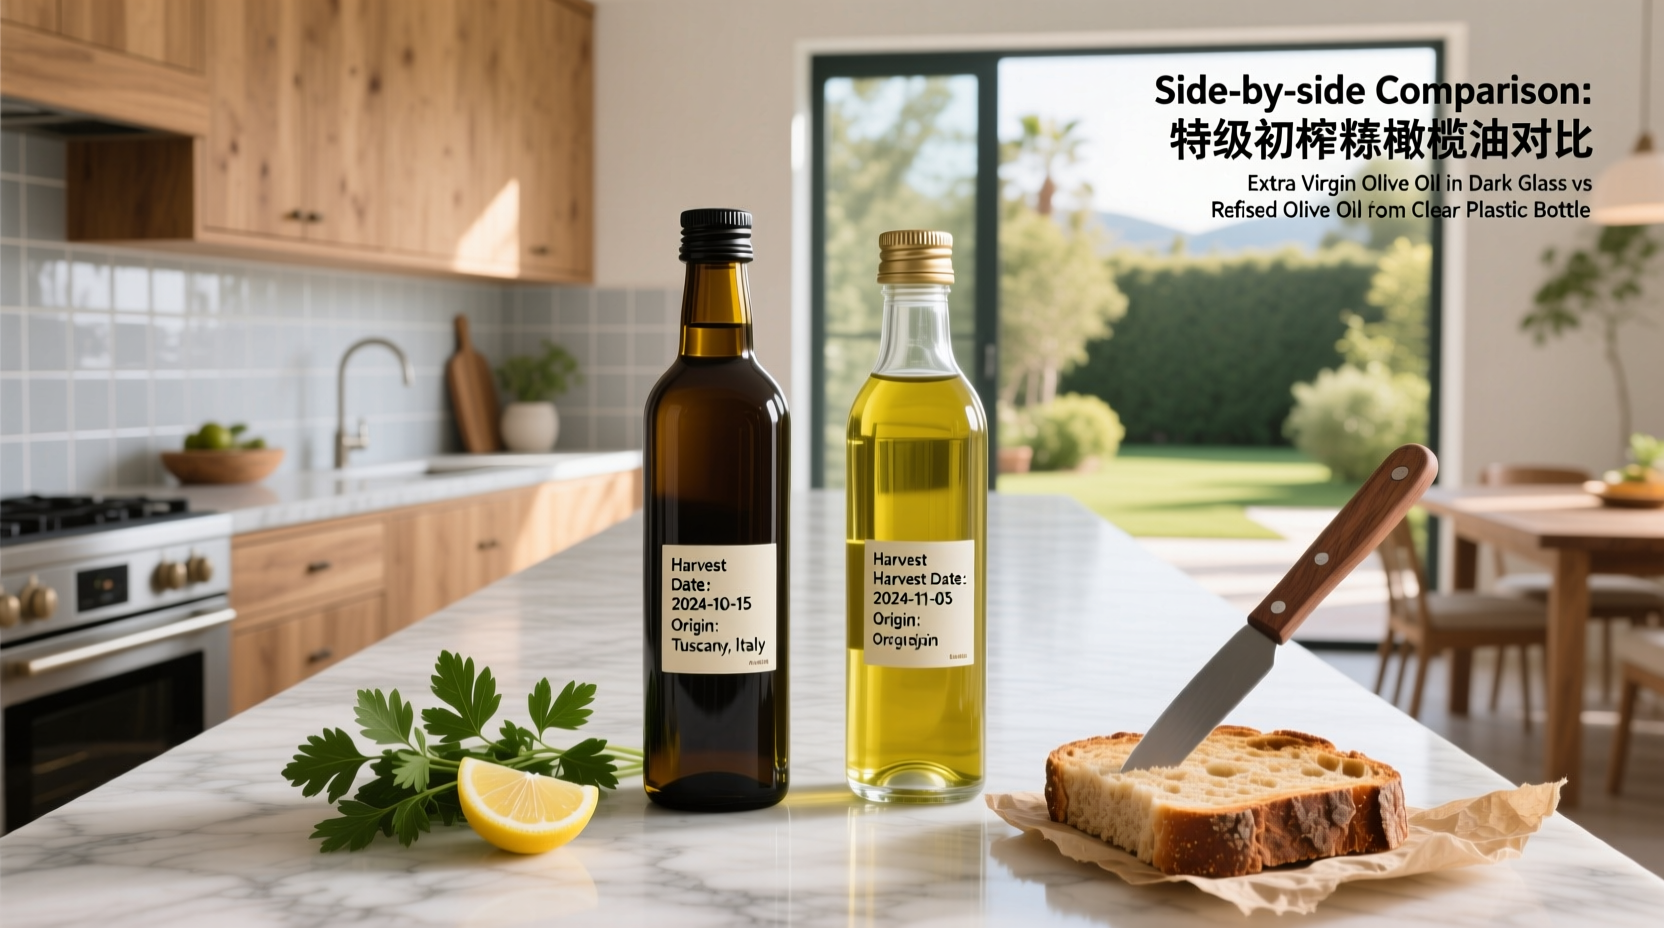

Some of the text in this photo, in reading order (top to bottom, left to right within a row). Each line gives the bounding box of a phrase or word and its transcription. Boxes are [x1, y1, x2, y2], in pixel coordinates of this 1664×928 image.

[671, 557, 727, 572] Harvest
[872, 551, 928, 567] Harvest
[671, 577, 711, 592] Date:
[873, 570, 967, 586] Harvest Date:
[671, 596, 752, 611] 2024-10-15
[873, 591, 953, 606] 2024-11-05
[671, 617, 719, 636] Origin:
[872, 611, 920, 630] Origin:
[671, 636, 766, 657] Tuscany, Italy
